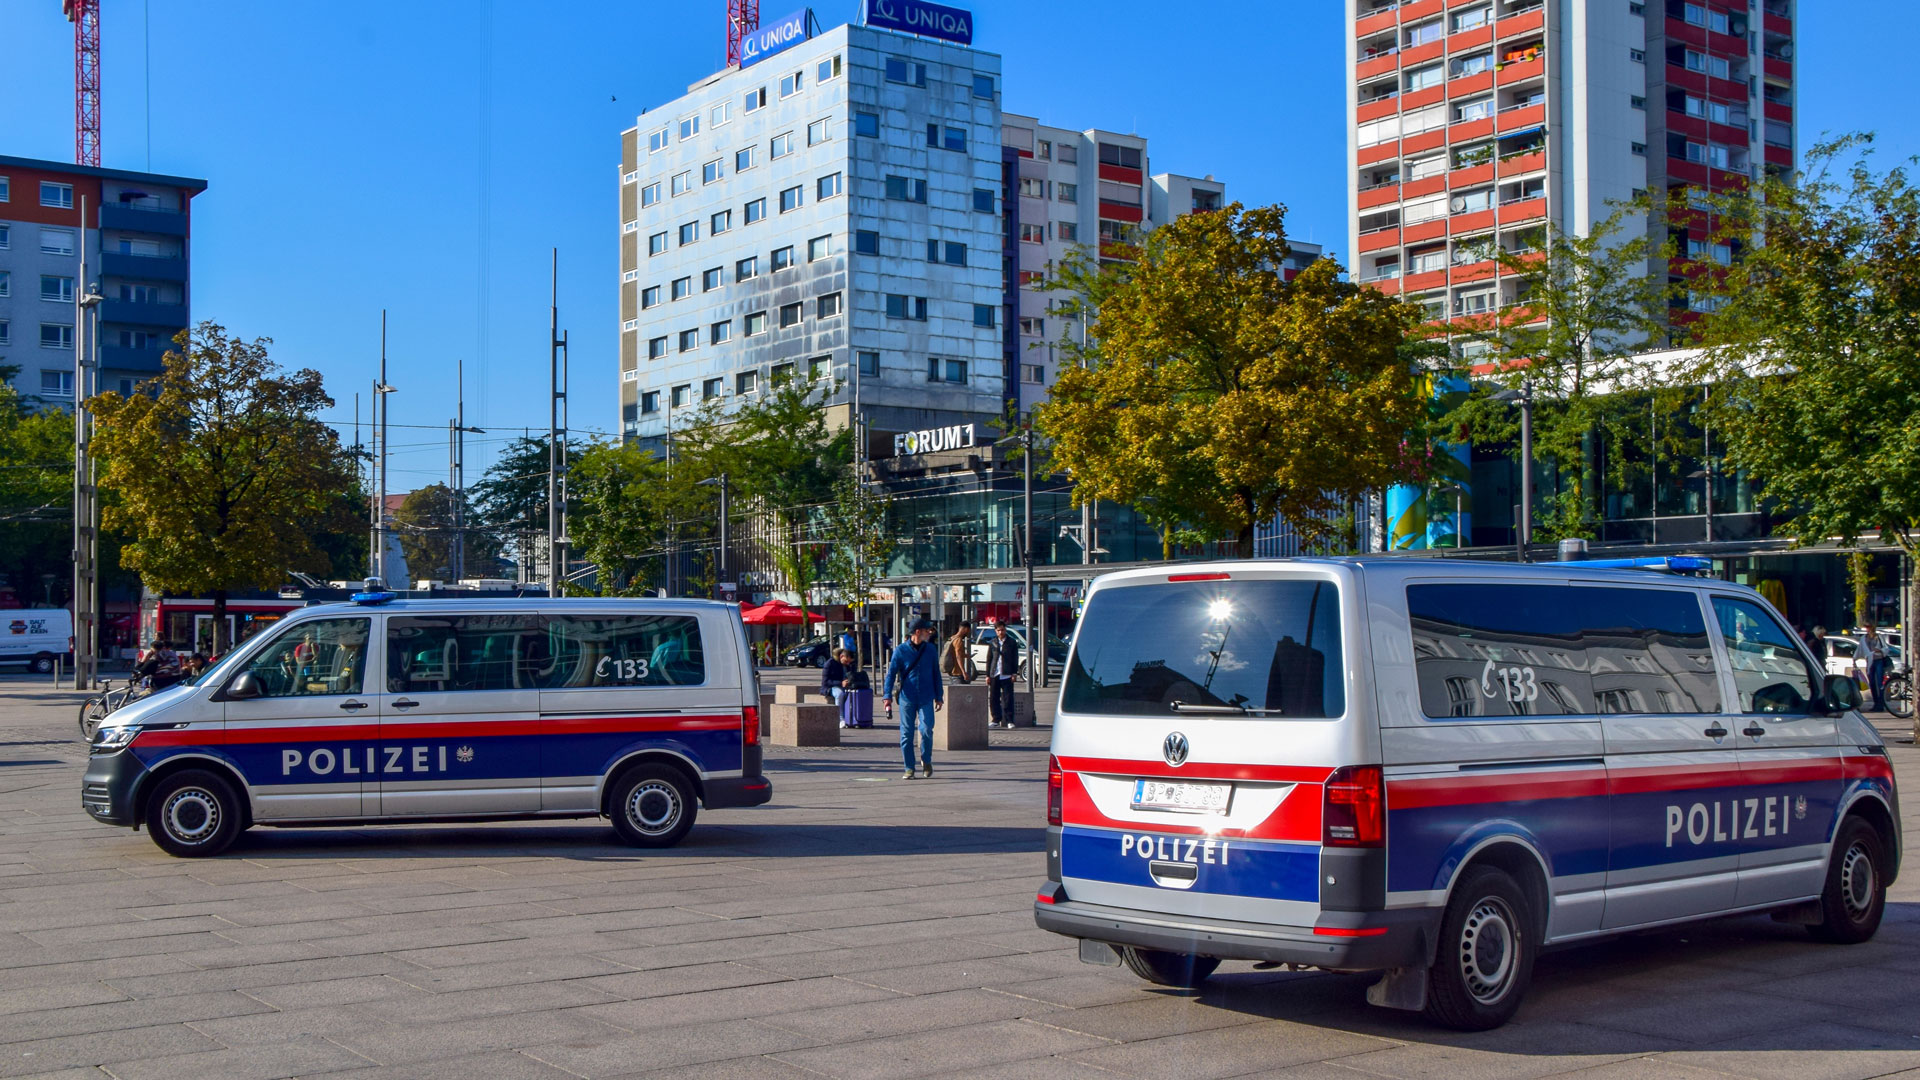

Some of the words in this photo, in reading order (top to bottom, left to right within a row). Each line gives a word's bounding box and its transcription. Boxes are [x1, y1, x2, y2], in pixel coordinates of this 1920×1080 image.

[761, 18, 803, 51] UNIQA
[905, 6, 969, 36] UNIQA
[613, 659, 649, 679] 133
[1498, 667, 1538, 702] 133
[282, 746, 447, 775] POLIZEI
[1666, 795, 1789, 847] POLIZEI
[1121, 834, 1229, 865] POLIZEI
